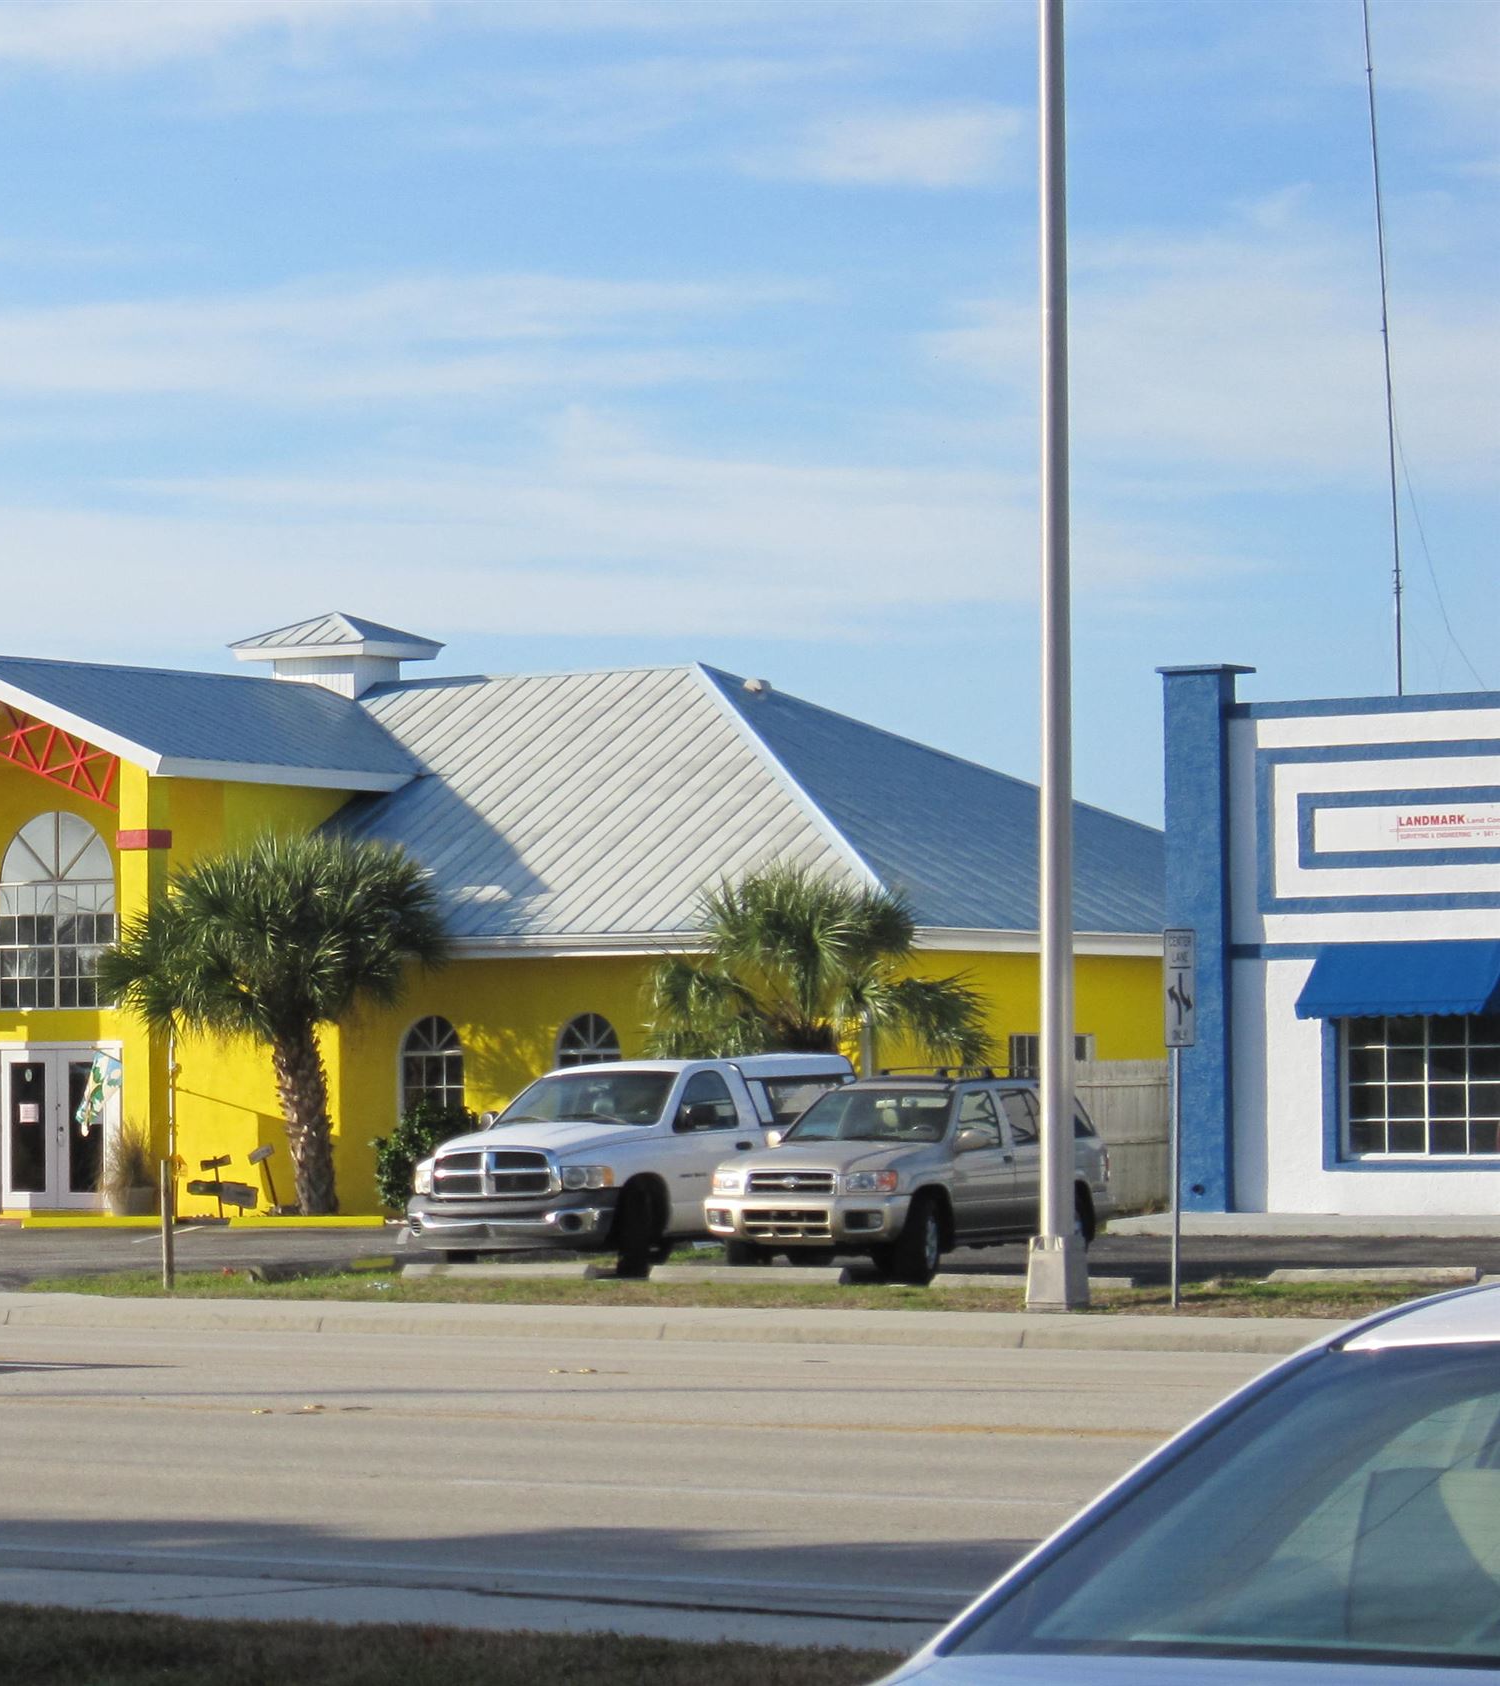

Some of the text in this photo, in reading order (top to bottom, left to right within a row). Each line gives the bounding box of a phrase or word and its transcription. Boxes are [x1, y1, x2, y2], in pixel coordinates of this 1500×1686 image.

[1399, 814, 1466, 827] LANDMARK
[1168, 935, 1192, 947] CENTER
[1172, 951, 1189, 963] LANE
